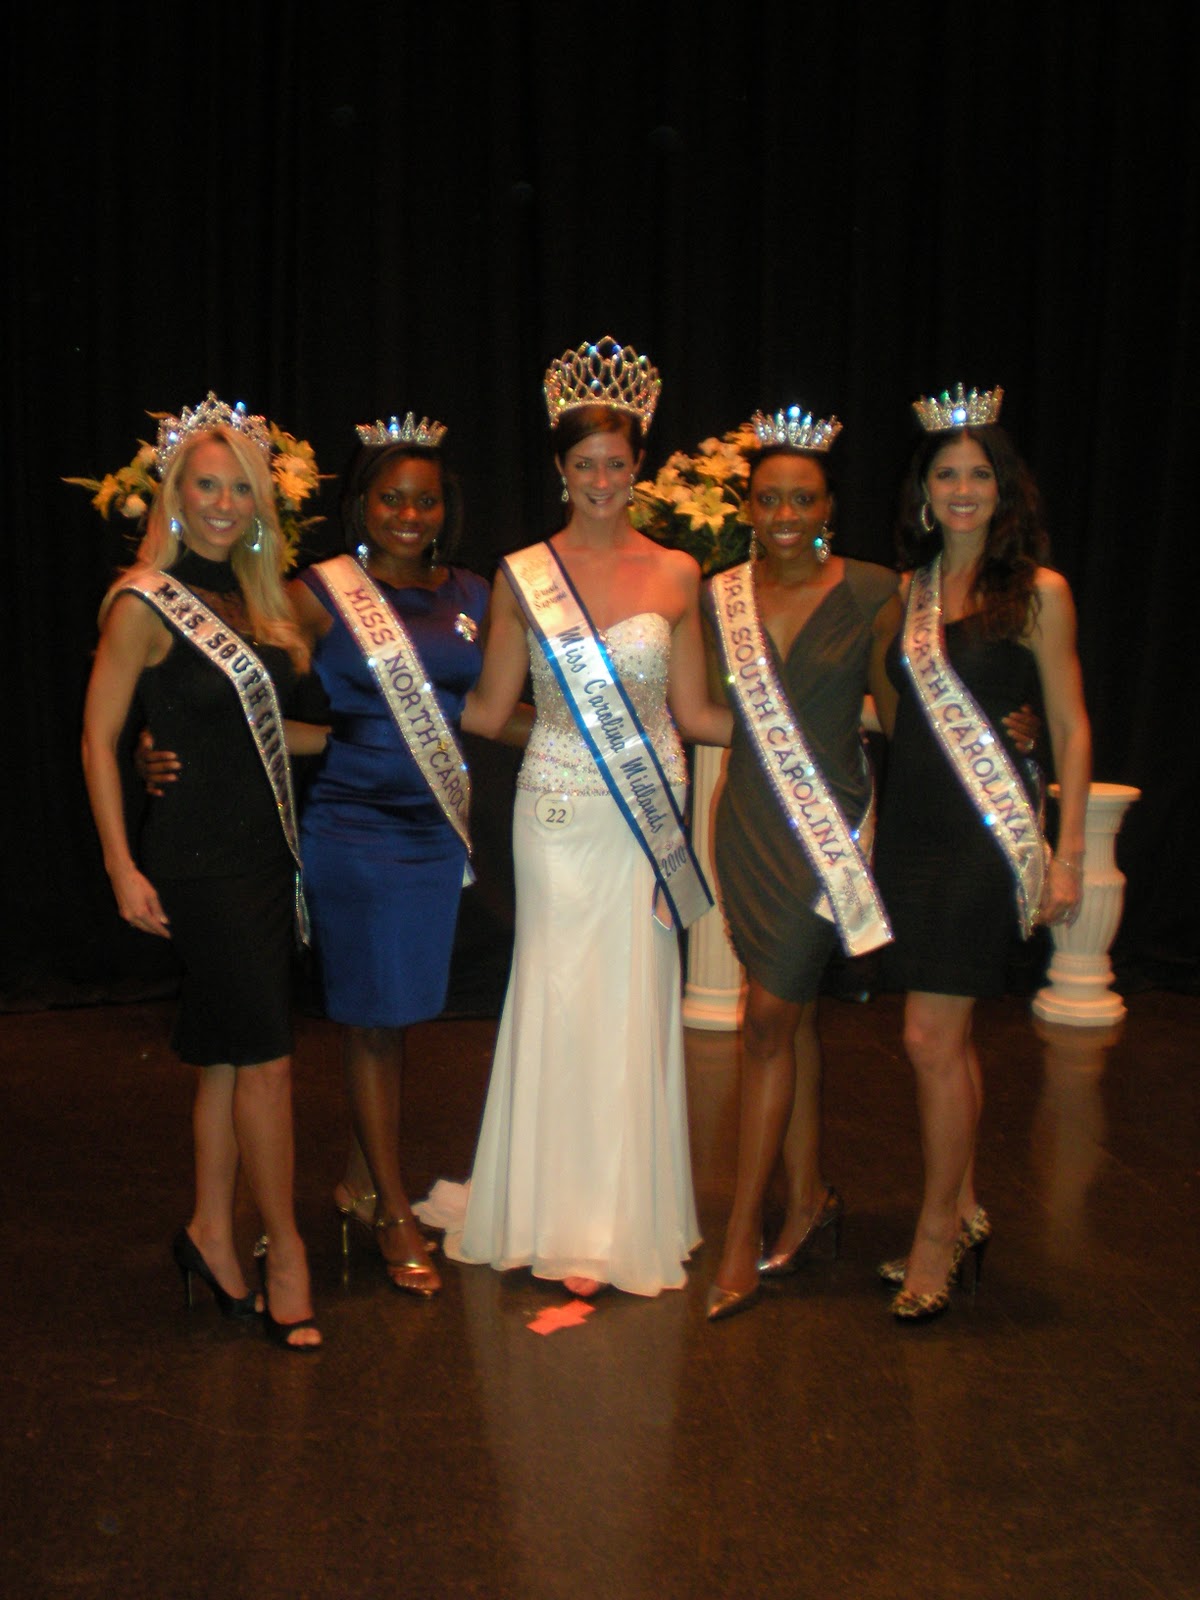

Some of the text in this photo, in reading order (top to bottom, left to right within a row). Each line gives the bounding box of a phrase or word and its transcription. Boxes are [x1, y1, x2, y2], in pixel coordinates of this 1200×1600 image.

[206, 632, 270, 708] SOUTH
[346, 588, 395, 645] MISS
[382, 652, 442, 749] NORTH
[556, 625, 665, 835] Miss Carolina Midlands
[731, 627, 777, 722] SOUTH
[767, 725, 847, 866] CAROLINA
[913, 612, 950, 701] NORTH
[942, 702, 1028, 844] CAROLINA
[545, 808, 567, 823] 22
[661, 845, 687, 878] 2010
